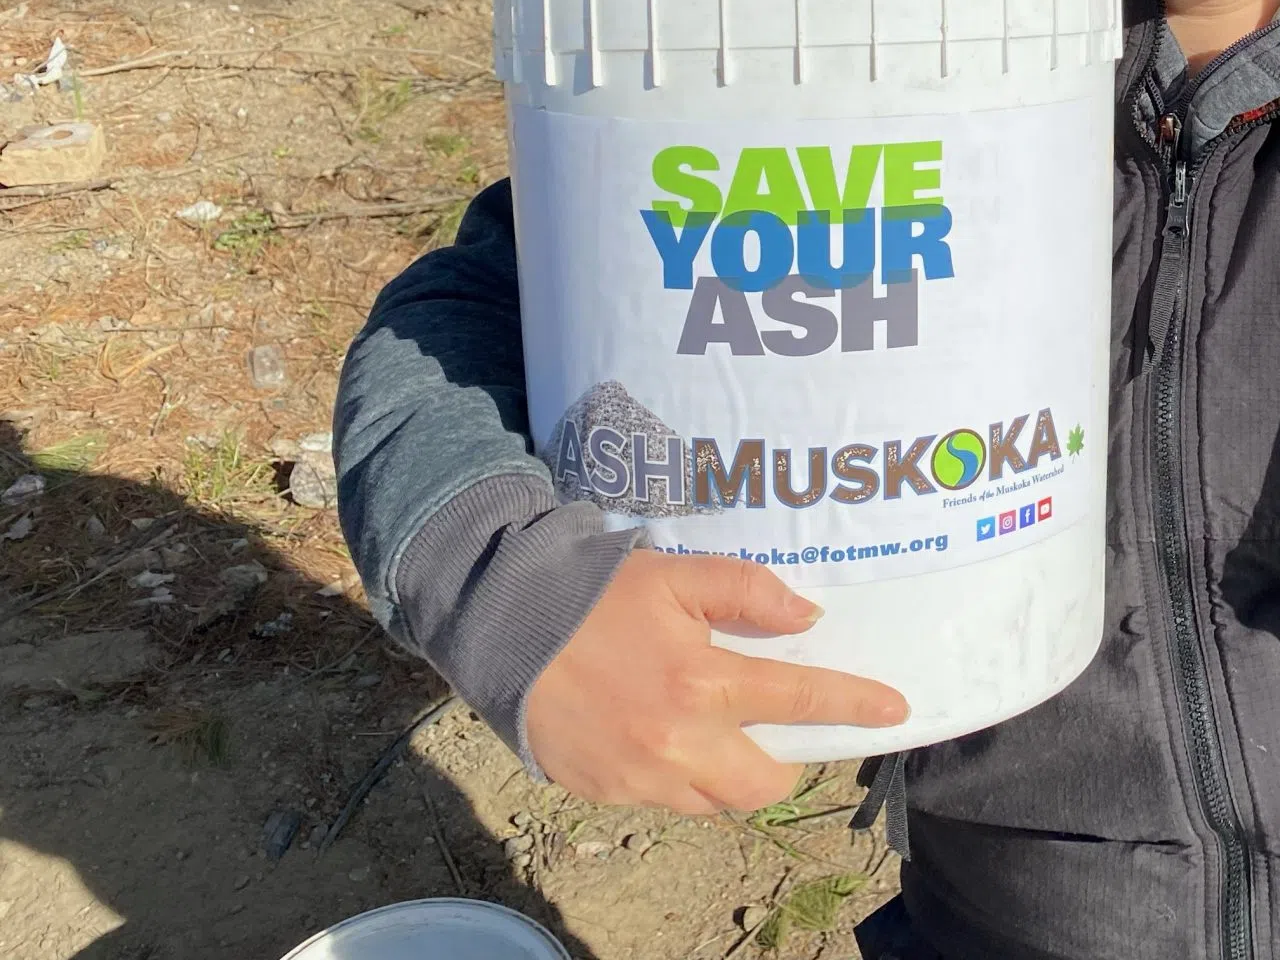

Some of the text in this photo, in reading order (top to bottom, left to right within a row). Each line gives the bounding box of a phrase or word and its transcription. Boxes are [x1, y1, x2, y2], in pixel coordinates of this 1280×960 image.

[651, 140, 944, 228] SAVE
[640, 203, 954, 293] YOUR
[676, 268, 919, 357] ASH
[943, 493, 977, 508] Friends
[996, 480, 1031, 497] Muskoka
[1032, 464, 1065, 485] Watershed
